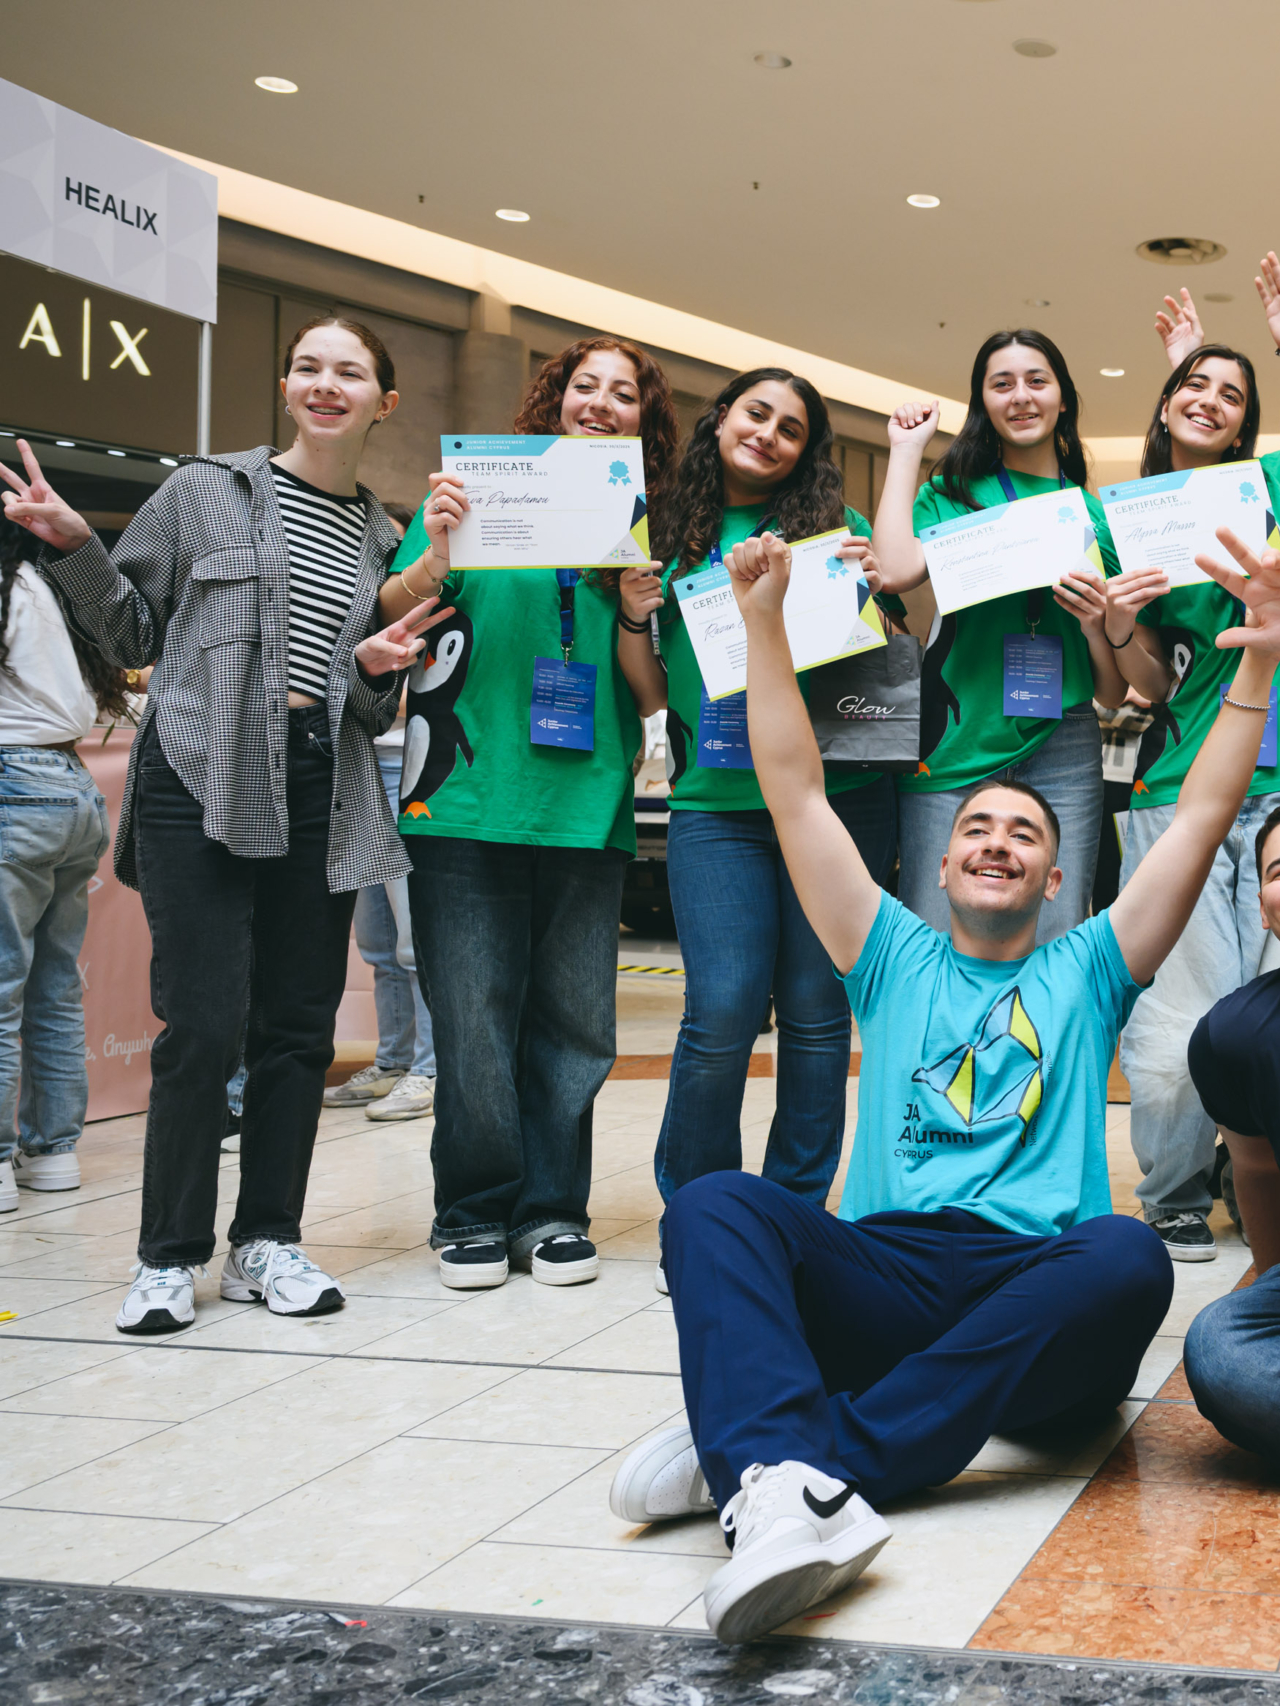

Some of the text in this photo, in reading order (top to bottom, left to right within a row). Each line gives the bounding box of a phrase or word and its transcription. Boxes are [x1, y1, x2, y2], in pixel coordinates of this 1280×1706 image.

[64, 175, 159, 236] HEALIX
[455, 462, 533, 471] CERTIFICATE
[1113, 494, 1179, 514] CERTIFICATE
[932, 524, 996, 549] CERTIFICATE
[692, 590, 733, 610] CERTIFI
[836, 696, 896, 715] Glow
[903, 1103, 921, 1122] JA
[898, 1126, 974, 1144] Alumni
[894, 1148, 933, 1160] CYPRUS
